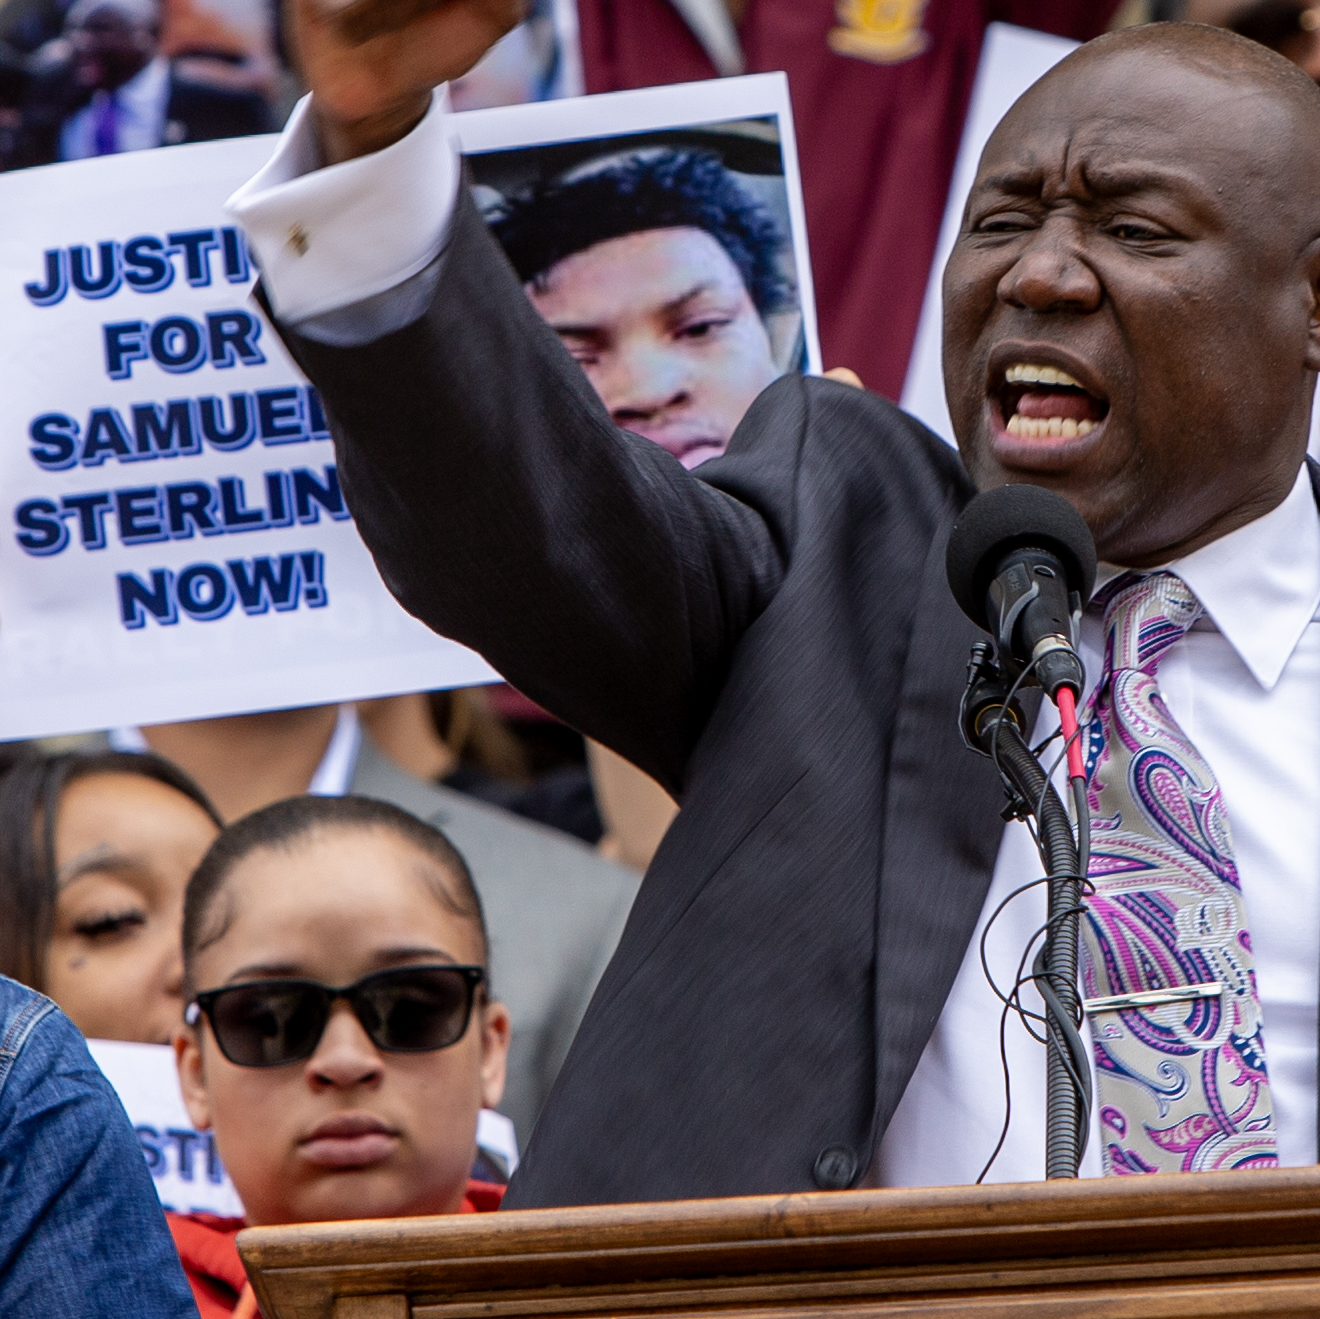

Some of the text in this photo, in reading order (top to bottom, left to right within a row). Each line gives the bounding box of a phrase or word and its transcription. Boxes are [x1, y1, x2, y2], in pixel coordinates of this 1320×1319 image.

[24, 226, 262, 307] JUSTI
[103, 309, 267, 381] FOR
[14, 465, 353, 557] STERLIN
[117, 551, 329, 629] NOW!
